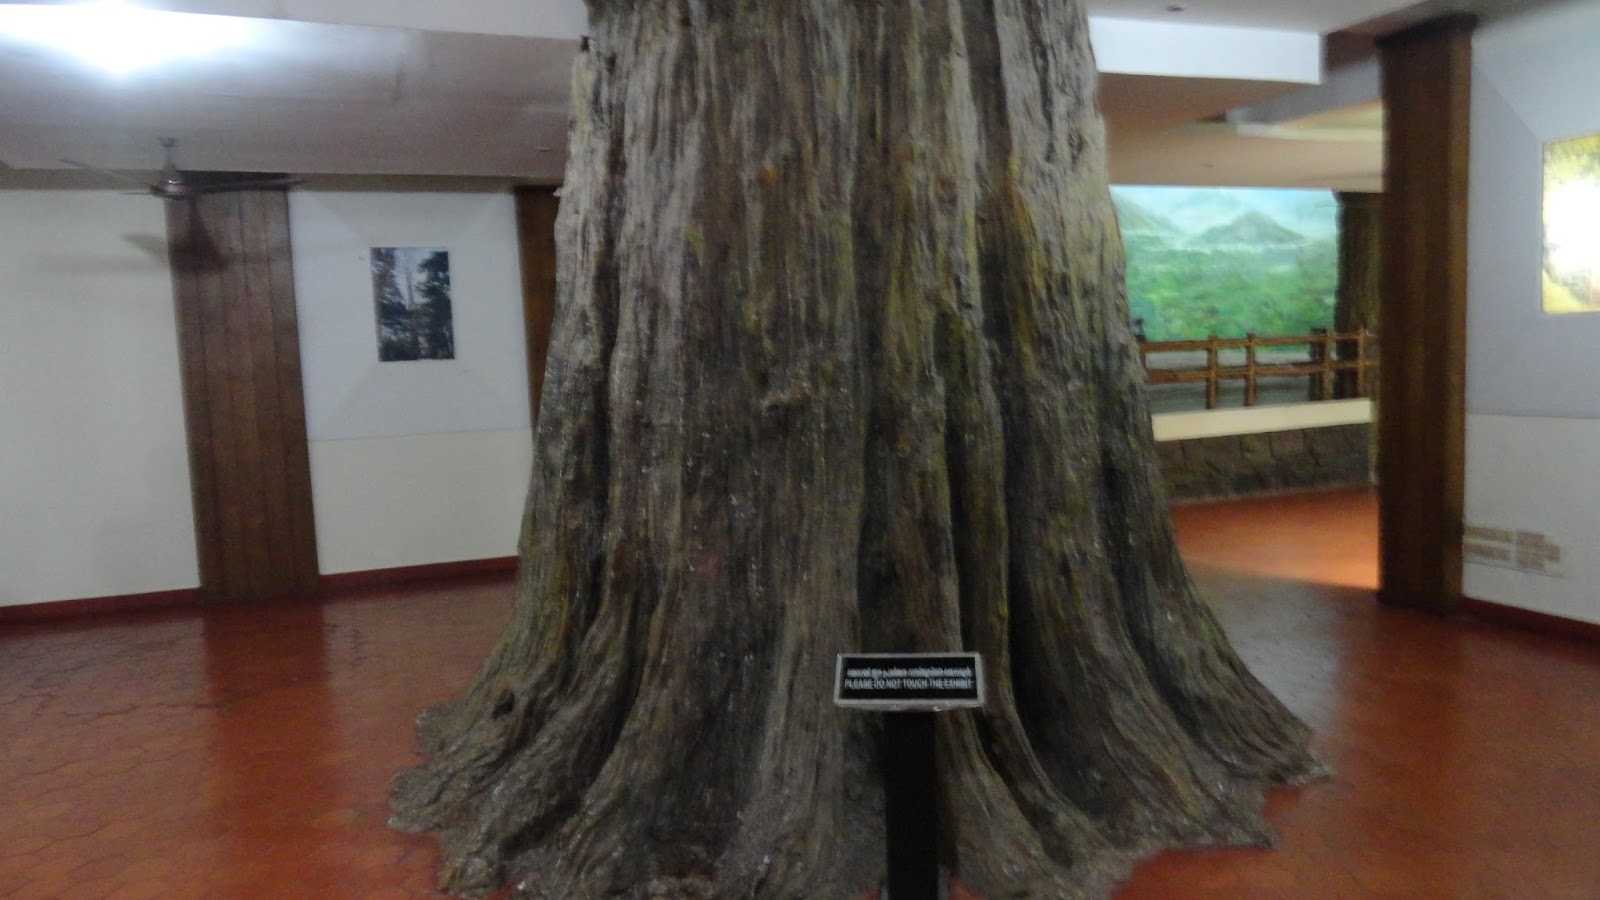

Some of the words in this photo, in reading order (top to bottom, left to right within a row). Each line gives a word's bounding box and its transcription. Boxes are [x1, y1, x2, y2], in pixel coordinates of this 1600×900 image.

[844, 678, 872, 689] PLEASE
[874, 679, 885, 689] DO
[886, 678, 901, 689] NOT
[903, 678, 928, 689] TOUCH
[929, 678, 942, 689] THE
[943, 678, 972, 689] EXHIBIT
